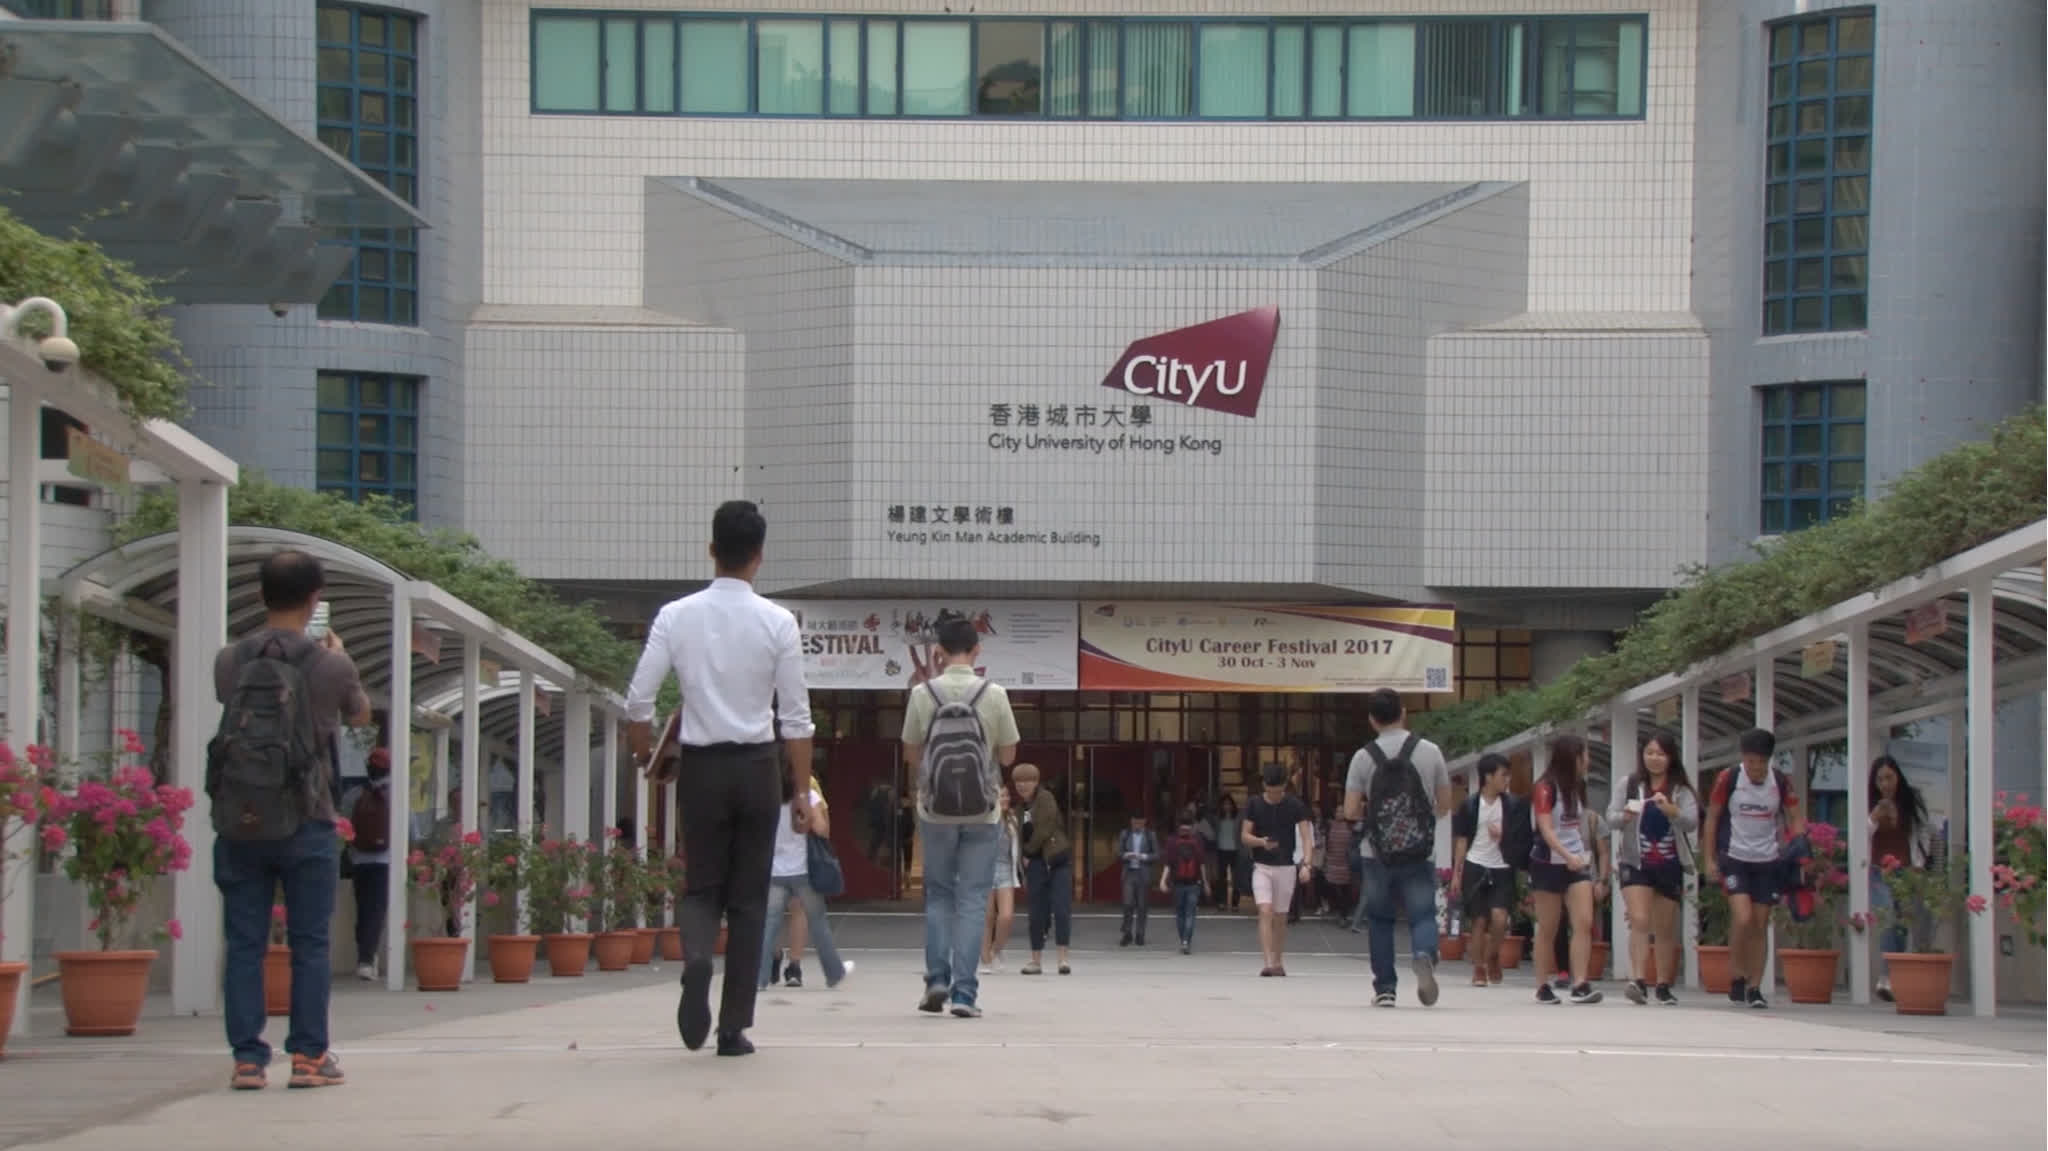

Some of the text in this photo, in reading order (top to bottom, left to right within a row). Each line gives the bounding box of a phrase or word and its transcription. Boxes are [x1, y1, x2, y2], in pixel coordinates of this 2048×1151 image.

[1123, 355, 1247, 405] CityU
[988, 403, 1153, 428] 香港城市大學
[988, 433, 1222, 454] City University of Hong Kong
[887, 530, 1101, 546] Yeung Kin Man Academic Building
[801, 633, 885, 655] ESTIVAL
[1146, 638, 1393, 655] CityU Career Festival 2017
[1217, 657, 1237, 669] 30
[1241, 657, 1265, 669] Oct
[1278, 657, 1287, 669] 3
[1291, 657, 1317, 669] Nov
